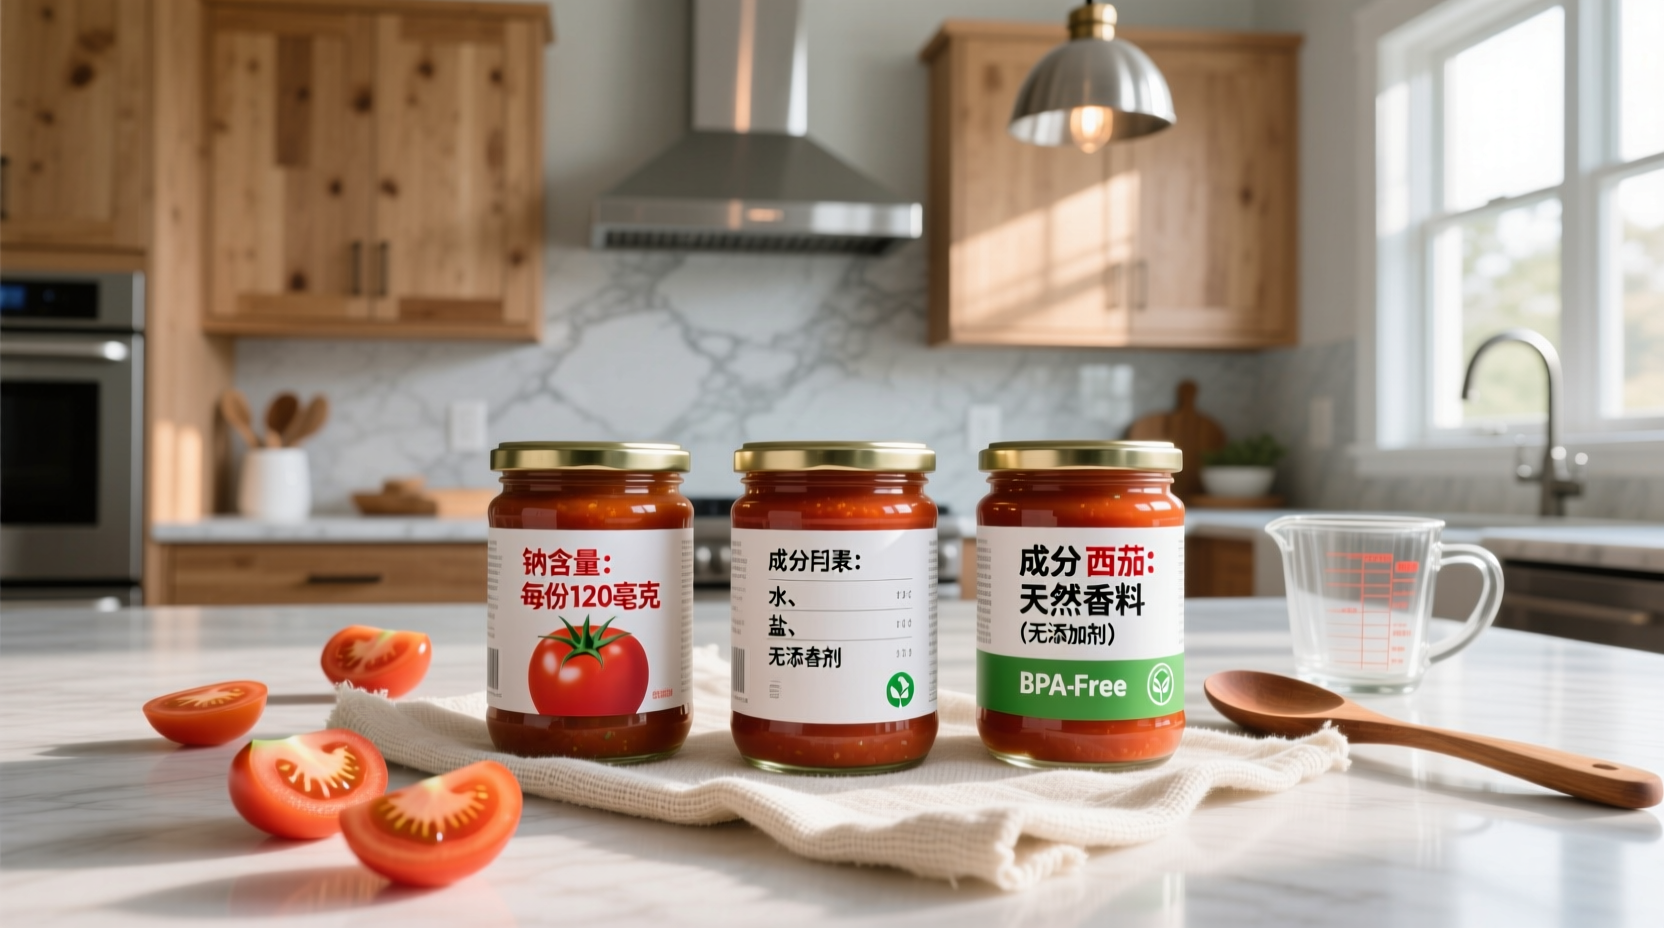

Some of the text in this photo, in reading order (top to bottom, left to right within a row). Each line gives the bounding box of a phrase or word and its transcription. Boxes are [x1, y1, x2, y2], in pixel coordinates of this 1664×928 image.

[523, 548, 611, 576] 钠含量：
[1019, 544, 1082, 577] 成分
[521, 580, 661, 611] 每份120毫克
[768, 585, 796, 608] 水、
[1019, 582, 1146, 616] 天然香料
[768, 614, 796, 637] 盐、
[1020, 671, 1127, 698] BPA-Free
